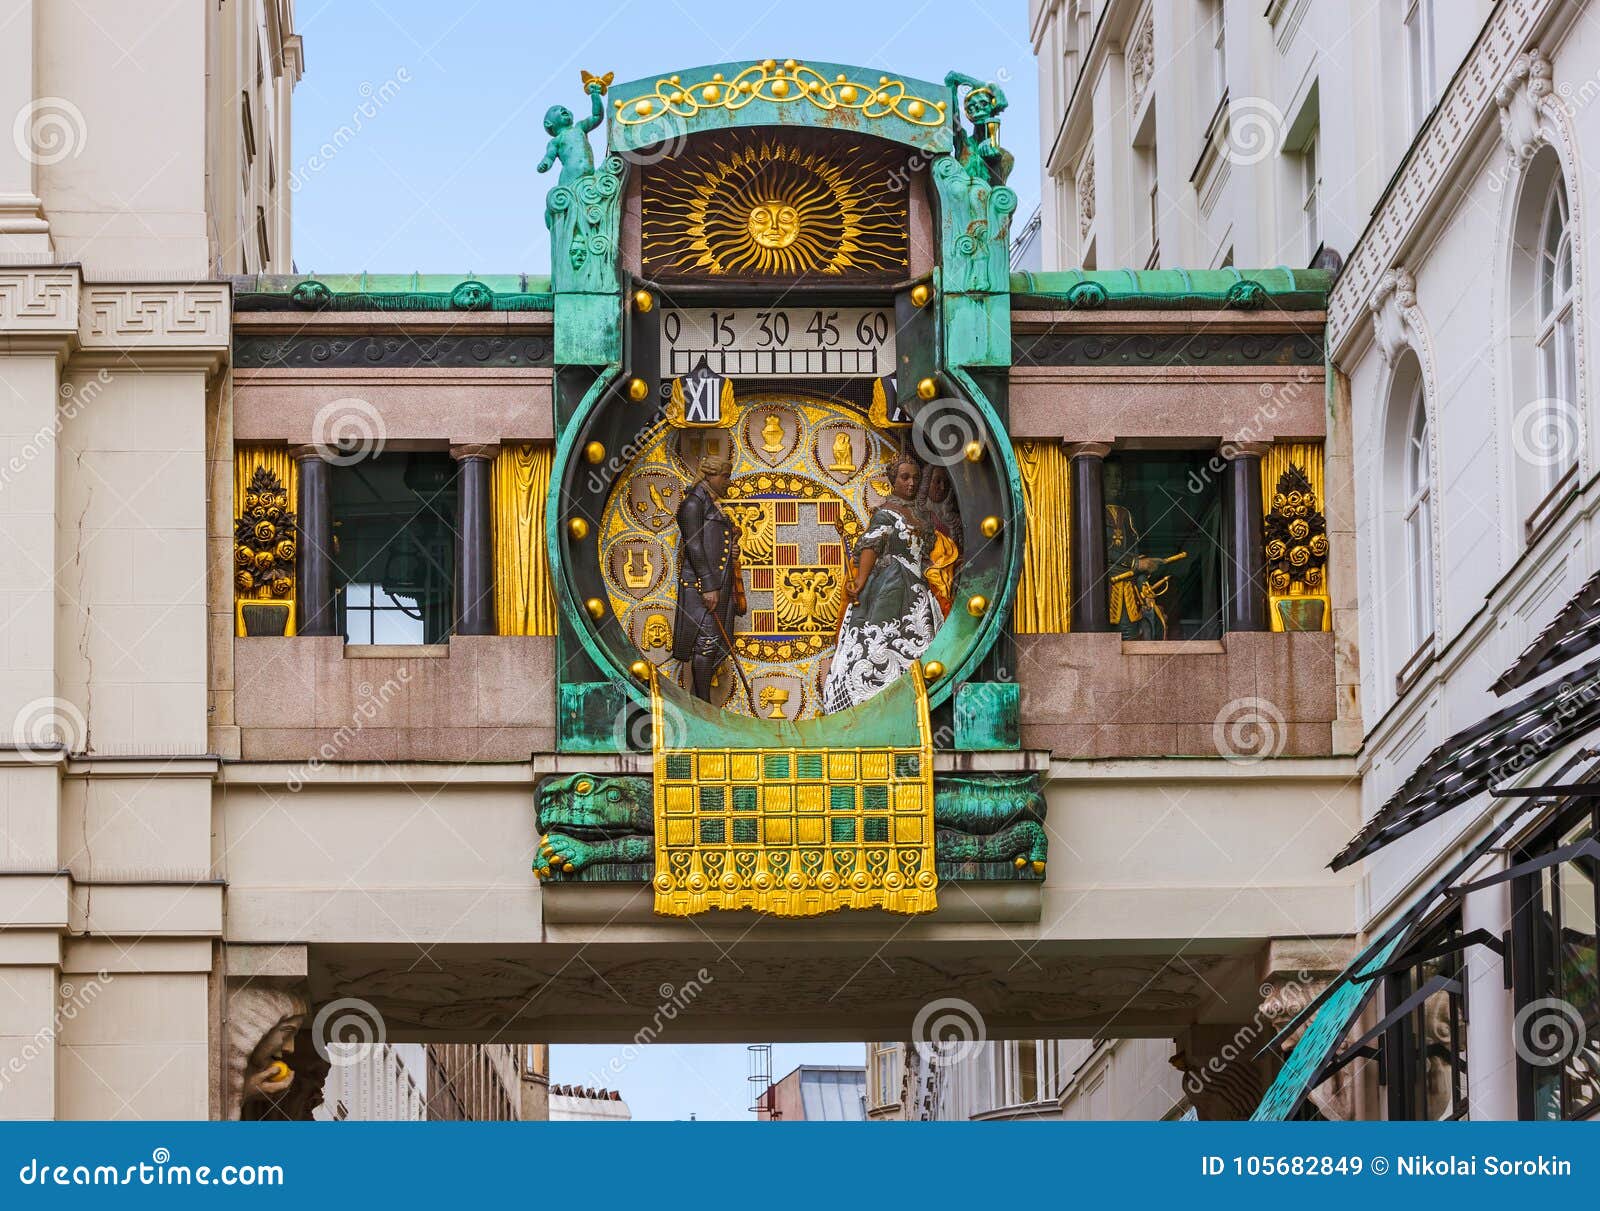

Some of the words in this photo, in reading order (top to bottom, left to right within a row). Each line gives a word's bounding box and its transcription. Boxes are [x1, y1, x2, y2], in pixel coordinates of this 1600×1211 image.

[664, 311, 681, 345] 0
[711, 312, 736, 347] 15
[756, 311, 790, 346] 30
[806, 311, 840, 347] 45
[856, 311, 888, 346] 60
[685, 377, 721, 422] XII
